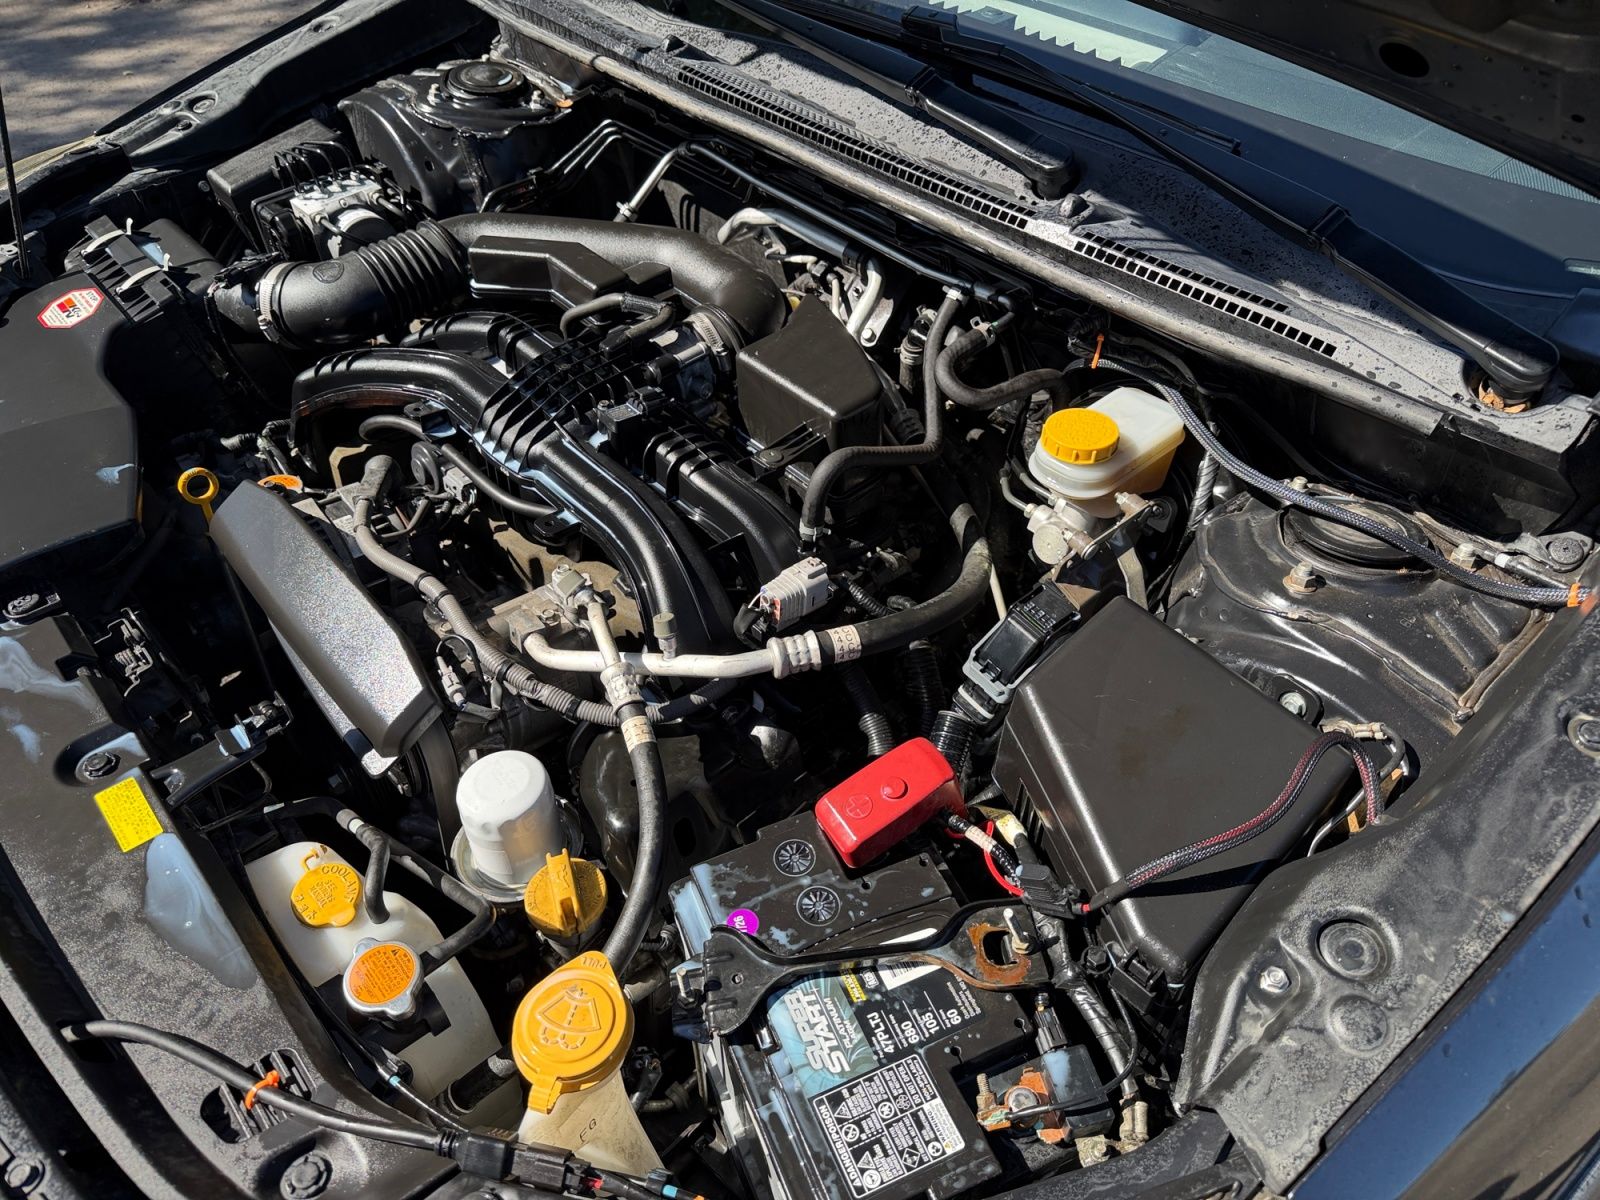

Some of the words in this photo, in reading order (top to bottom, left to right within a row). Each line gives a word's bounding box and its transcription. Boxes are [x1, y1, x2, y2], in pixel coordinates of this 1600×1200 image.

[321, 865, 358, 903] COOLANT
[782, 992, 829, 1068] SUPER
[795, 991, 850, 1072] START
[823, 997, 853, 1048] PLATINUM
[867, 1011, 896, 1054] 47PLTJ
[900, 1019, 920, 1045] 680
[922, 1011, 940, 1034] 105
[945, 1007, 962, 1026] 60
[896, 1063, 909, 1082] OPEN.
[905, 1080, 916, 1094] NOT
[906, 1057, 931, 1100] NON-SPILLABLE
[912, 1093, 921, 1103] DO
[818, 1105, 857, 1179] DANGER/POISON
